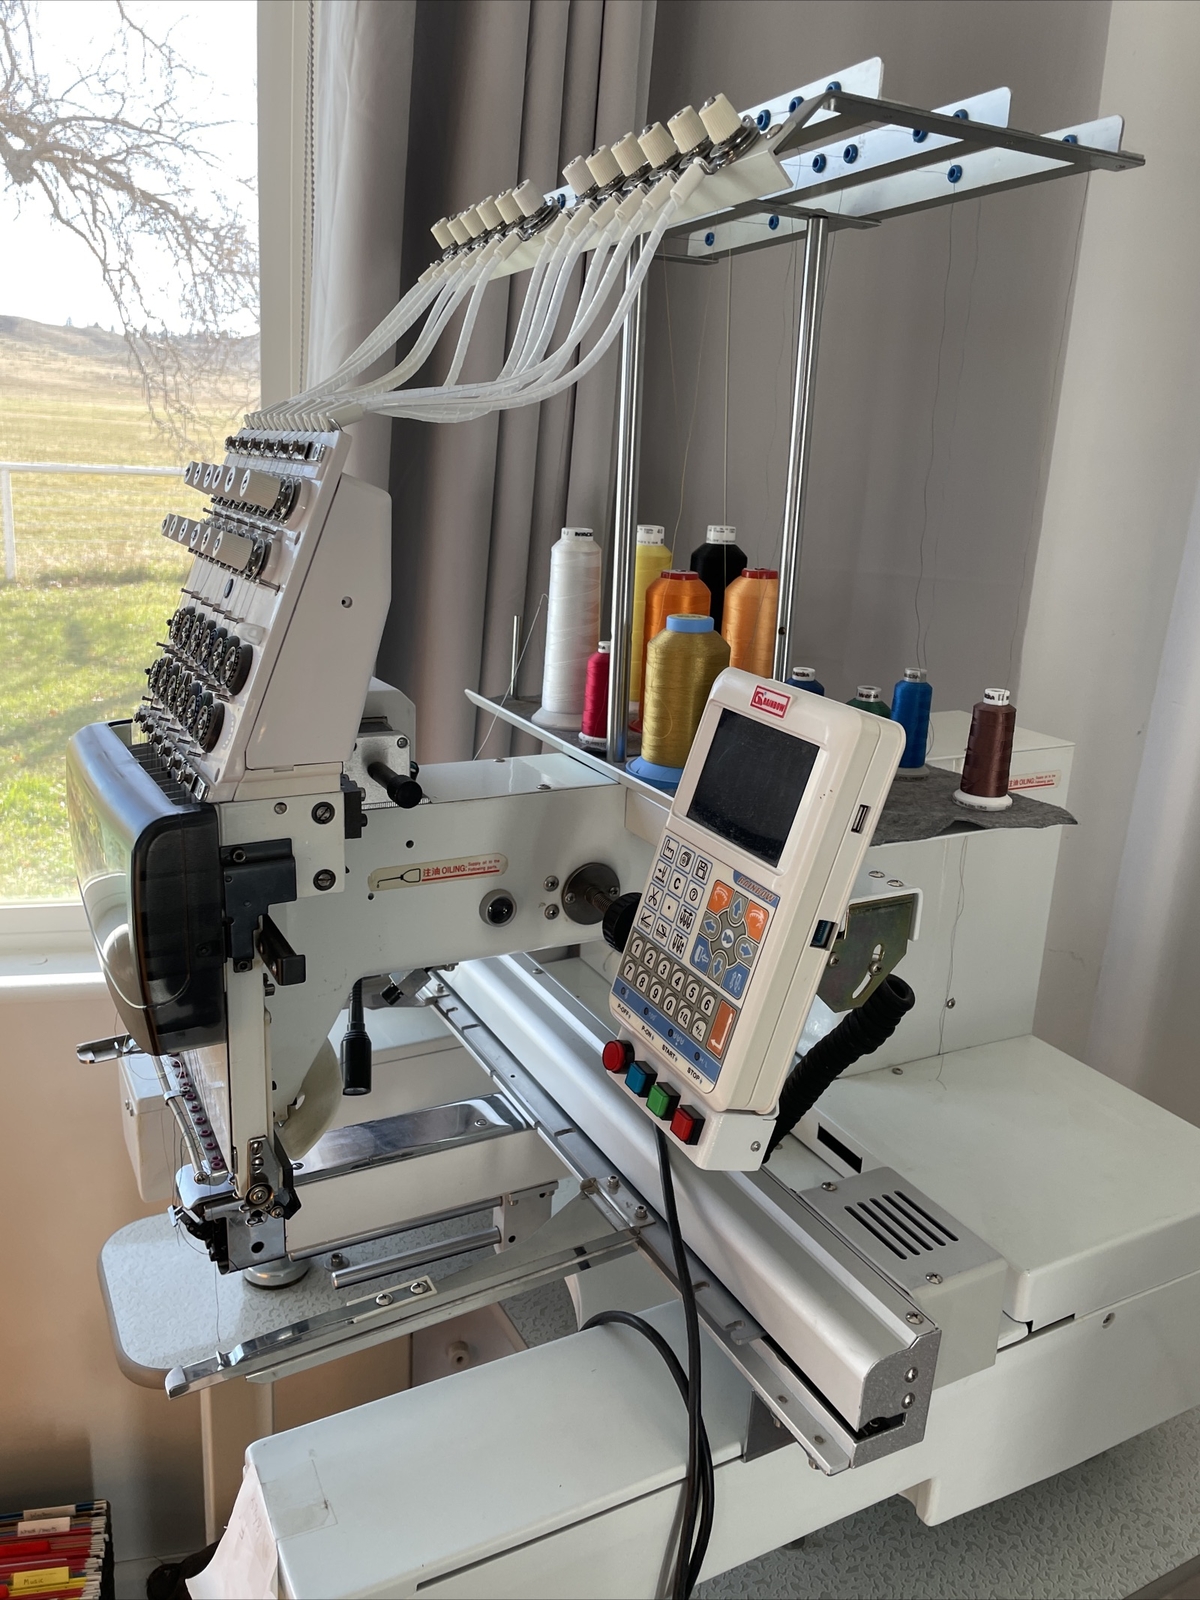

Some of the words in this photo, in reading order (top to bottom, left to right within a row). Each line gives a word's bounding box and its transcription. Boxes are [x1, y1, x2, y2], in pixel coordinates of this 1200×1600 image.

[673, 877, 681, 890] C
[737, 875, 775, 903] RAINBOW
[634, 943, 639, 954] 1
[646, 953, 653, 965] 2
[625, 965, 632, 977] 7
[661, 964, 668, 976] 3
[639, 976, 646, 988] 8
[674, 975, 681, 987] 4
[652, 988, 659, 999] 9
[688, 986, 696, 999] 5
[666, 1000, 673, 1011] 0
[703, 999, 711, 1011] 6
[662, 1045, 676, 1061] START
[687, 1067, 700, 1081] STOP
